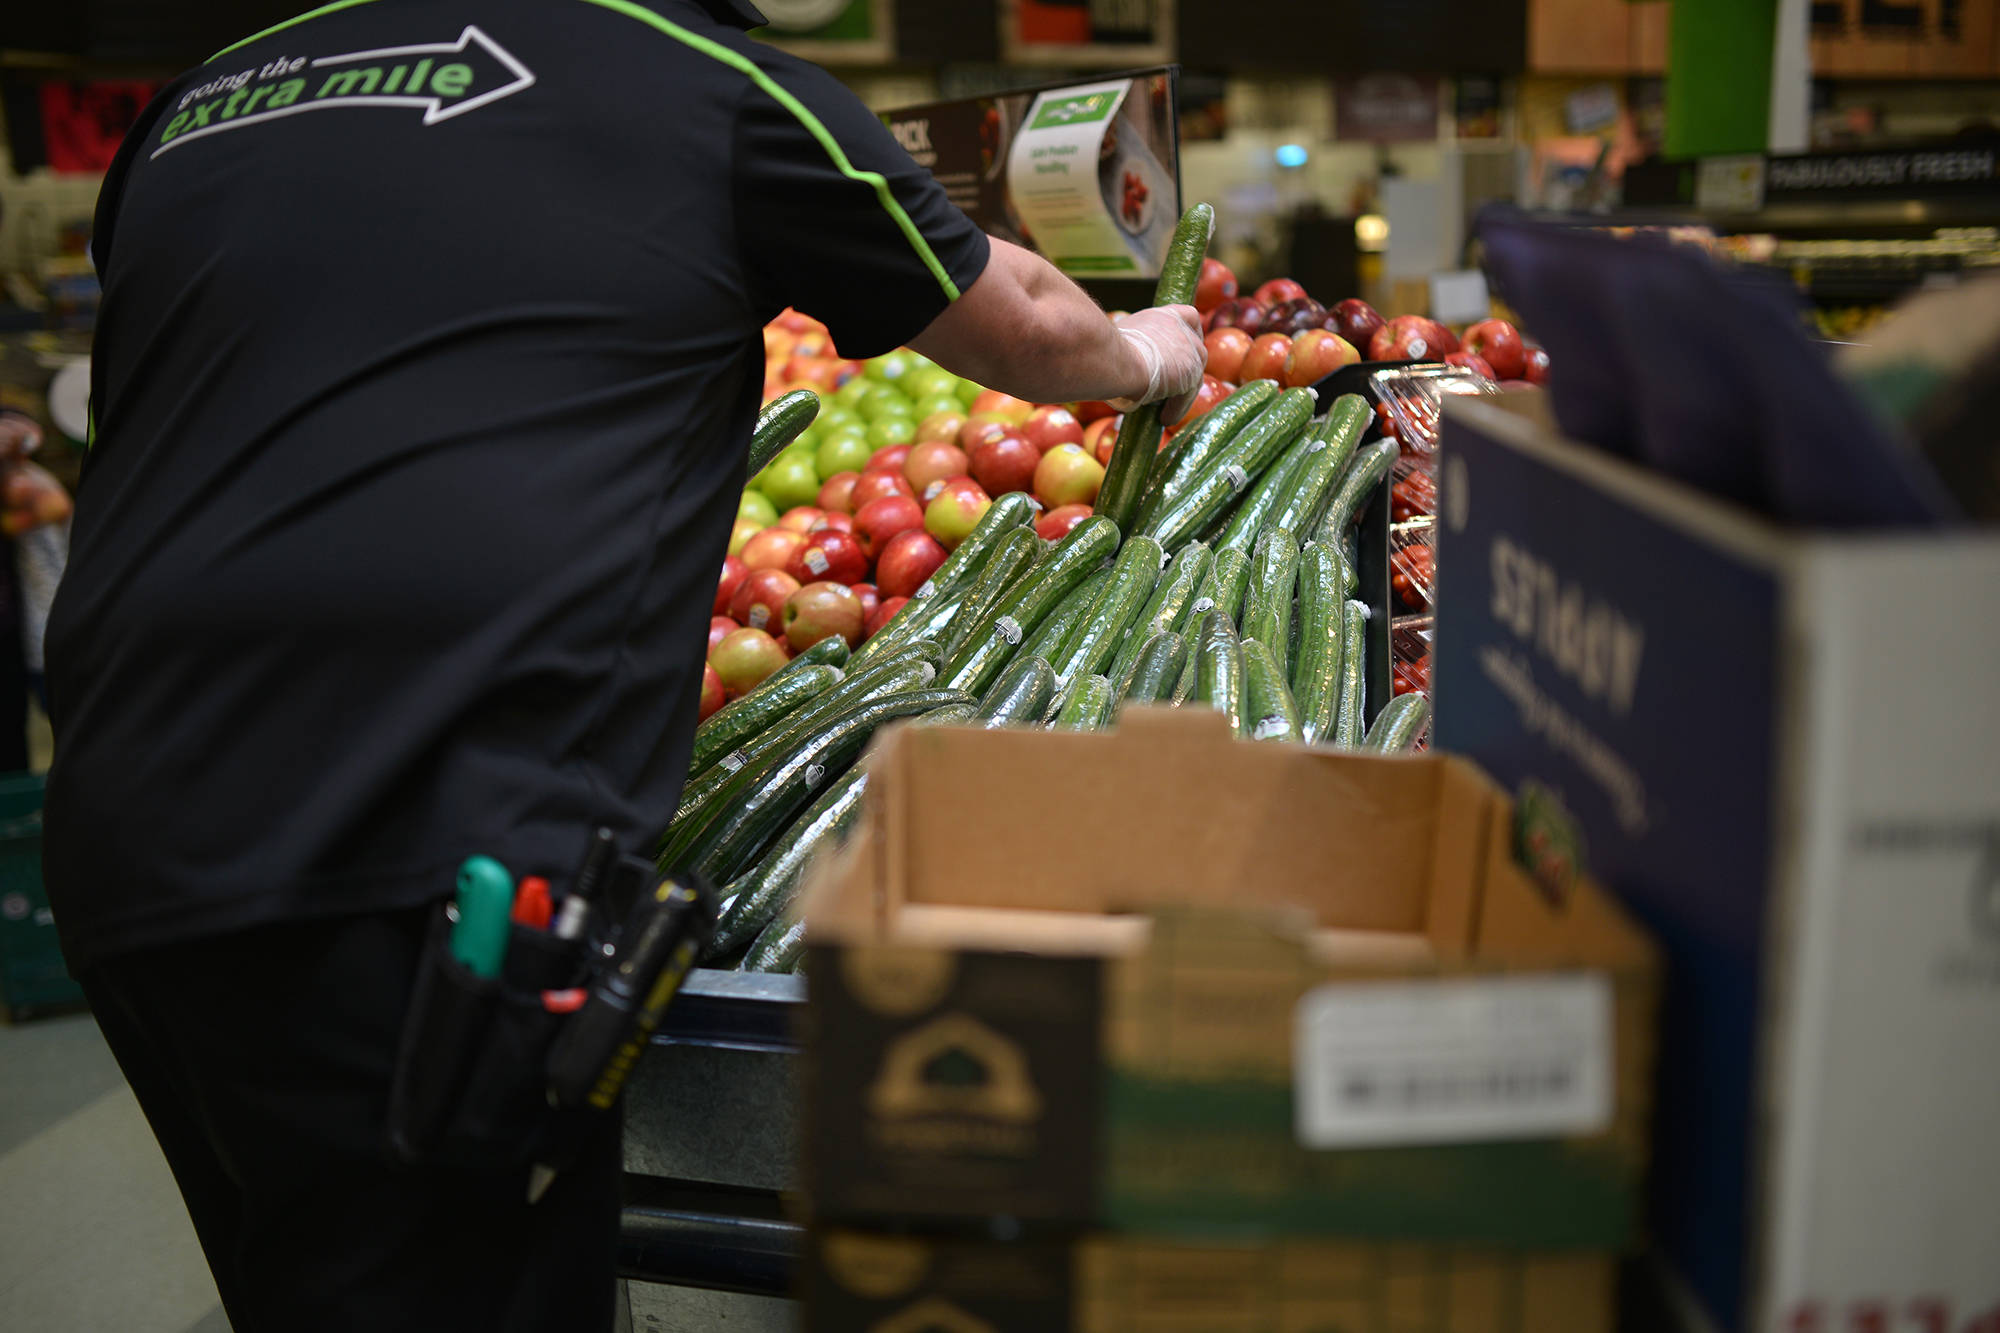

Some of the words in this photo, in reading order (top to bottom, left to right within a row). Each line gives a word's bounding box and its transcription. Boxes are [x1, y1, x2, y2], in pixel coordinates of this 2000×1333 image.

[160, 77, 306, 143] extra
[315, 58, 474, 97] mile
[177, 68, 256, 112] going
[258, 55, 307, 80] the
[1911, 151, 1995, 183] FRESH
